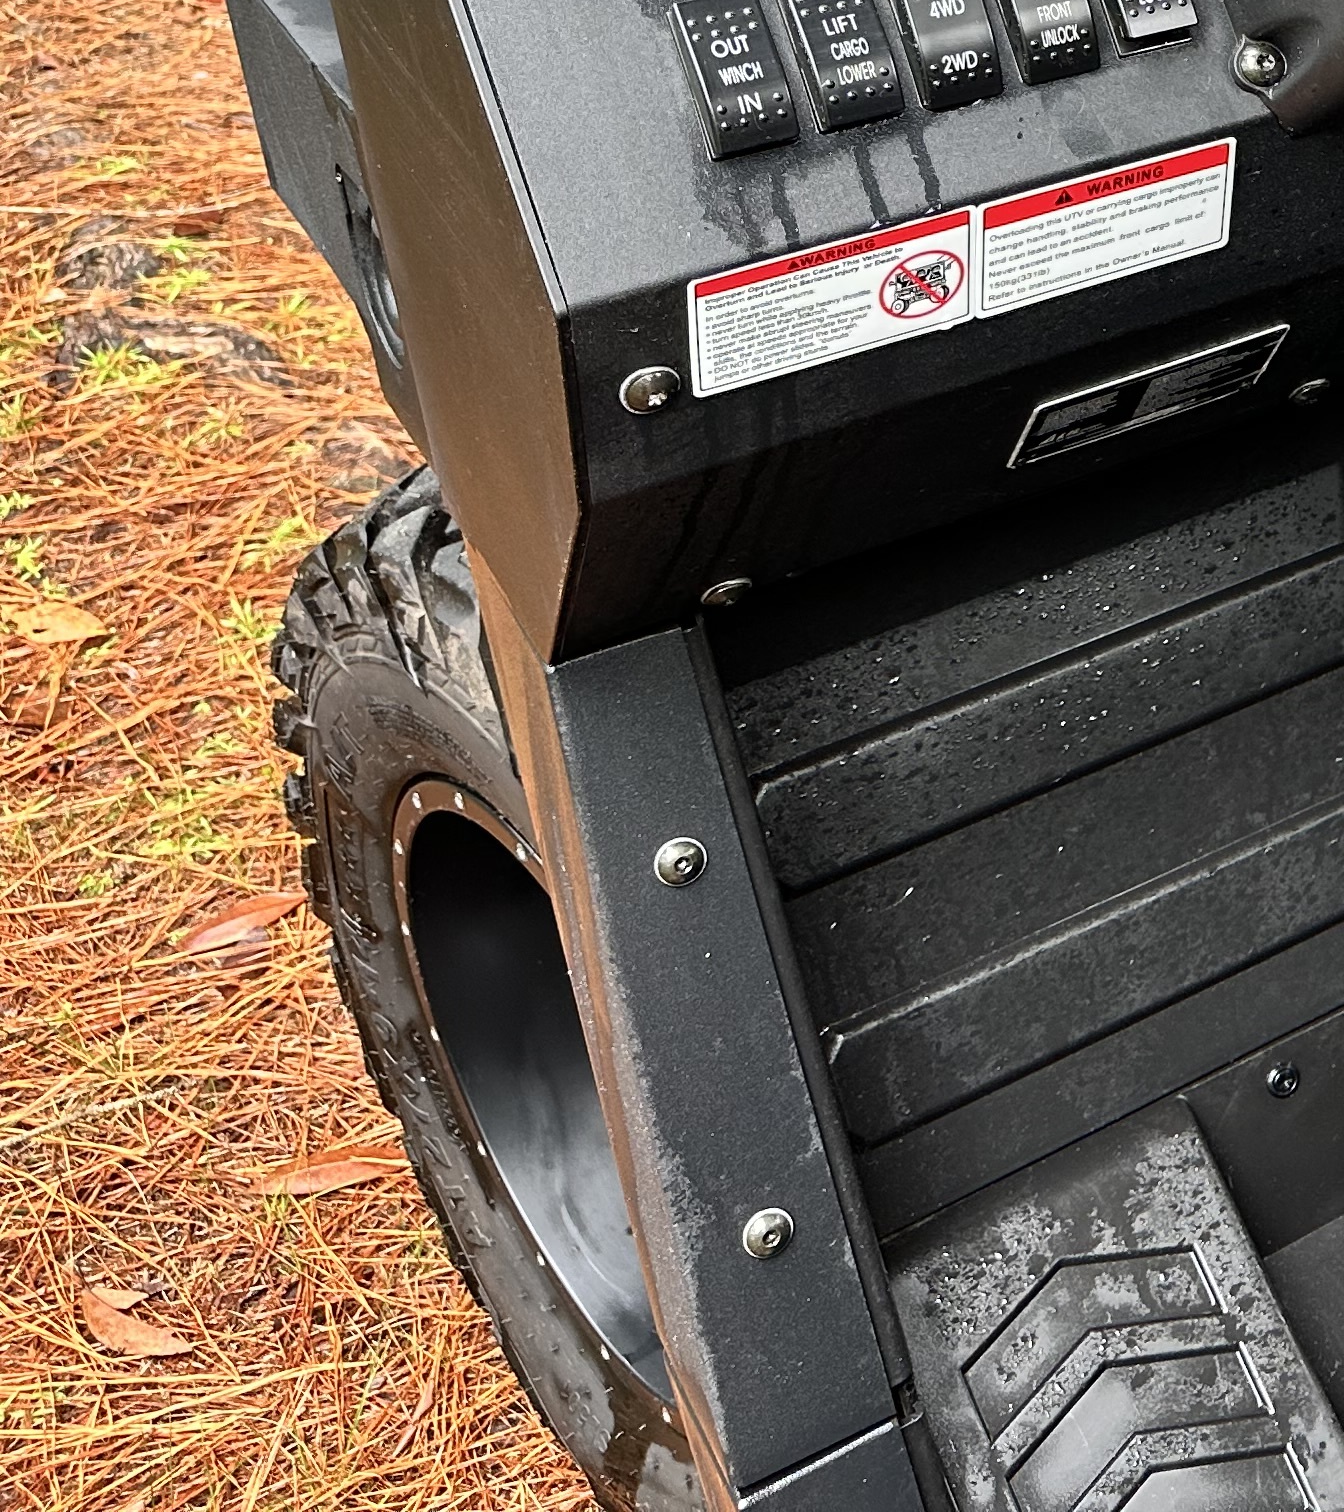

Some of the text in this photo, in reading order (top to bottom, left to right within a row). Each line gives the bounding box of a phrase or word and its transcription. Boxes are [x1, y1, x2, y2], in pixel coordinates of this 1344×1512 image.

[1036, 0, 1074, 24] FRONT
[822, 13, 859, 37] LIFT
[1041, 24, 1081, 49] UNLOCK
[710, 34, 750, 59] OUT
[830, 37, 870, 61] CARGO
[718, 61, 764, 87] WINCH
[837, 61, 878, 86] LOWER
[941, 50, 978, 74] 2WD
[737, 92, 763, 115] IN
[1086, 165, 1164, 196] WARNING
[989, 223, 1044, 242] Overloading
[1046, 218, 1062, 226] this
[1064, 210, 1083, 221] UTV
[1133, 191, 1158, 201] cargo
[1160, 178, 1204, 195] improperly
[1205, 174, 1220, 182] can
[989, 241, 1024, 254] change
[1072, 217, 1107, 231] stability
[1109, 210, 1126, 220] and
[1129, 201, 1162, 215] braking
[1164, 186, 1219, 206] performance
[799, 239, 876, 266] WARNING
[989, 267, 1017, 278] Never
[1019, 255, 1052, 270] exceed
[1072, 238, 1115, 254] maximum
[1119, 229, 1140, 240] front
[1145, 222, 1170, 233] cargo
[1175, 214, 1193, 225] limit
[989, 257, 1006, 266] and
[1009, 253, 1025, 261] can
[1027, 245, 1047, 256] lead
[705, 290, 745, 307] Improper
[748, 278, 791, 293] Operation
[793, 273, 810, 281] Can
[813, 265, 839, 275] Cause
[842, 259, 860, 267] This
[862, 250, 892, 261] Vehicle
[705, 298, 745, 311] Overturn
[747, 292, 763, 300] and
[765, 285, 787, 295] Lead
[800, 274, 833, 286] Serious
[835, 267, 859, 276] Injury
[988, 291, 1014, 302] Refer
[1029, 271, 1081, 290] instructions
[1096, 262, 1109, 270] the
[716, 310, 738, 320] order
[750, 300, 772, 310] avoid
[714, 365, 728, 374] DO
[730, 359, 749, 369] NOT
